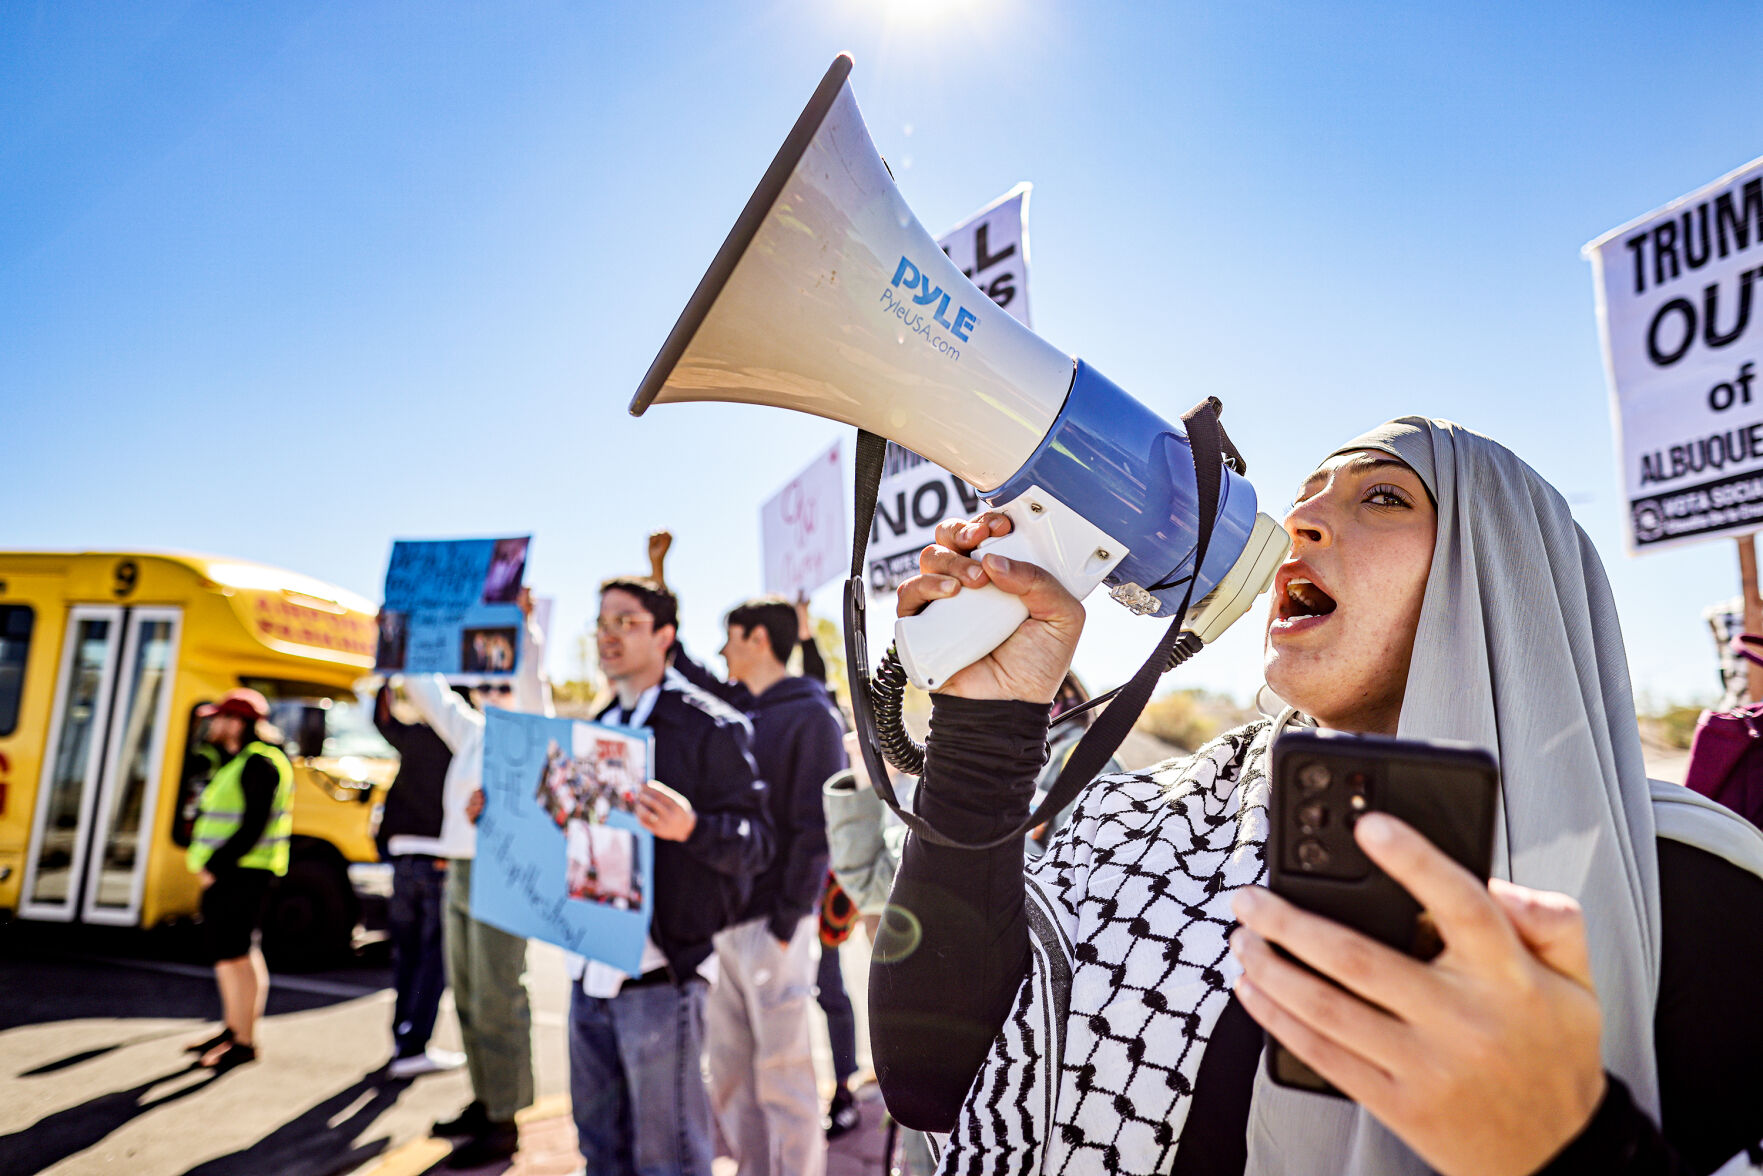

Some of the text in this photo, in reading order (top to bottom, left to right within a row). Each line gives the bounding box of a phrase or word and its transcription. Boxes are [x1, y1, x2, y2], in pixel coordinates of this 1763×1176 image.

[1625, 177, 1763, 293] TRUM
[880, 288, 960, 361] PyleUSA.com
[891, 255, 978, 343] PYLE
[1646, 266, 1763, 367] OU
[1708, 362, 1755, 412] of
[115, 562, 138, 597] 9
